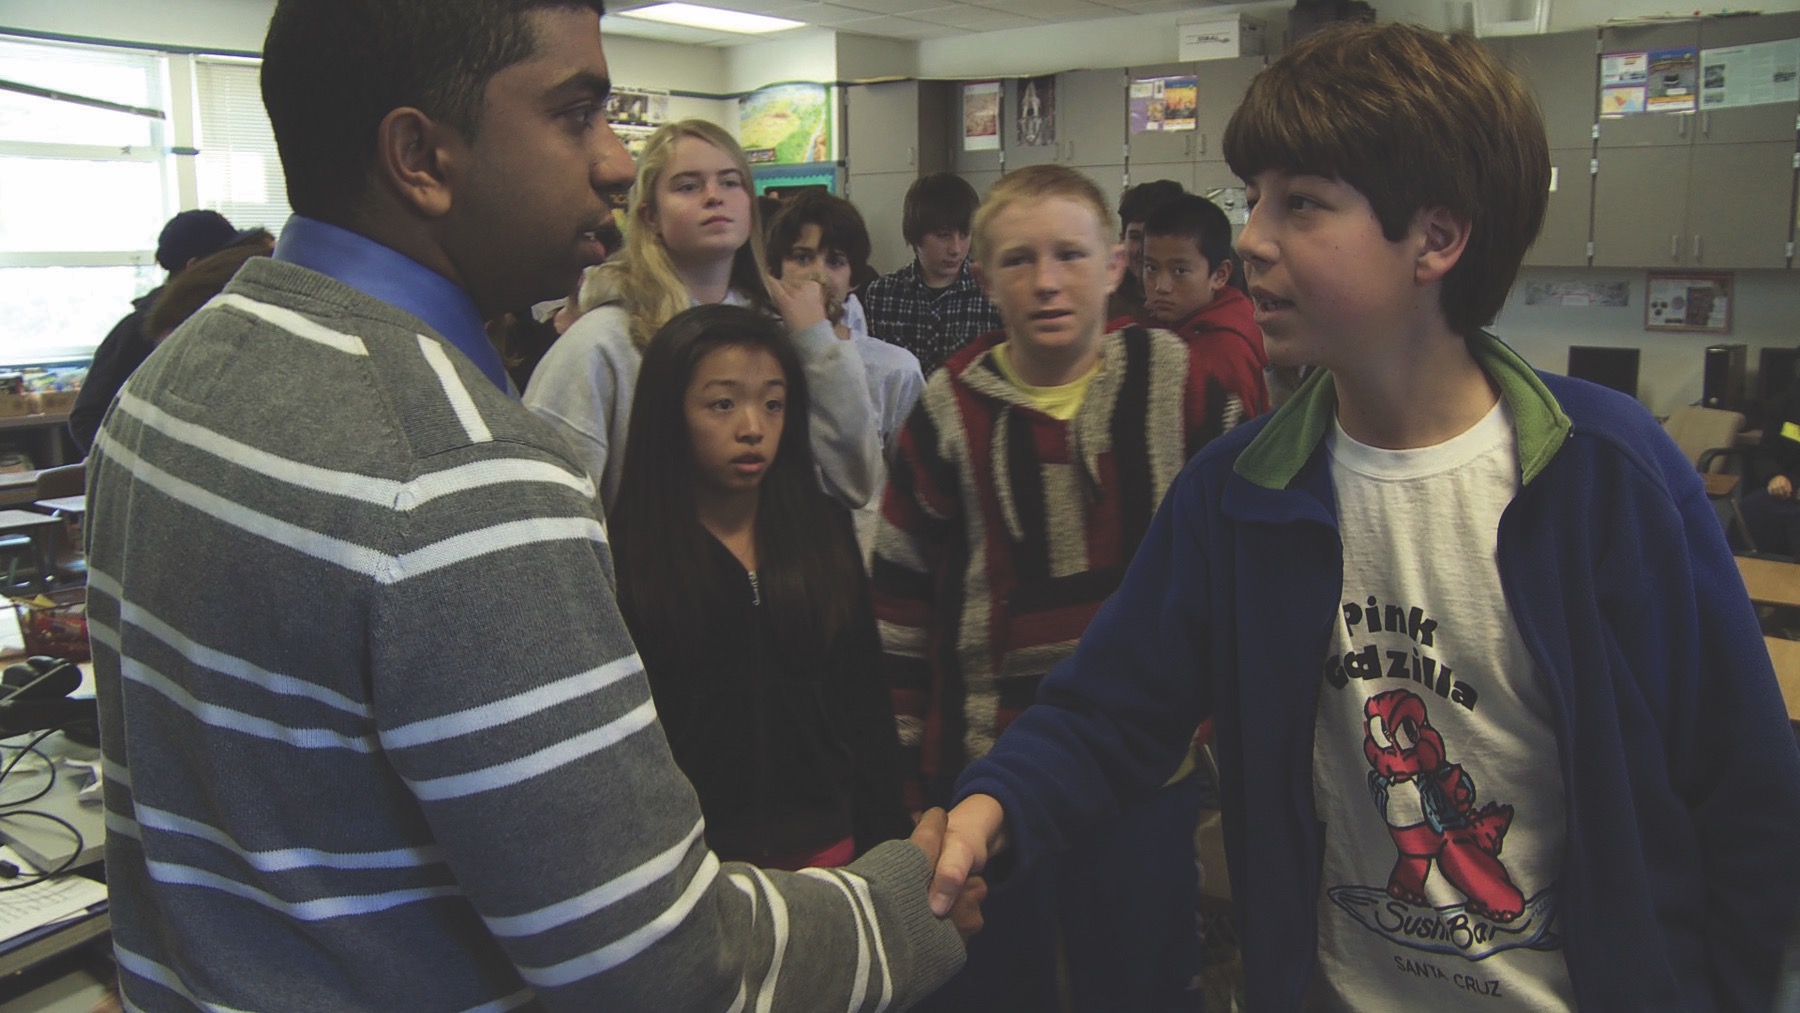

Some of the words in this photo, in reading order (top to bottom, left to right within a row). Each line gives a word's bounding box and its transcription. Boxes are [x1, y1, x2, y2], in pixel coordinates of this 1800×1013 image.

[1343, 596, 1438, 648] Pink
[1394, 955, 1449, 981] SANTA
[1454, 973, 1502, 997] CRUZ
